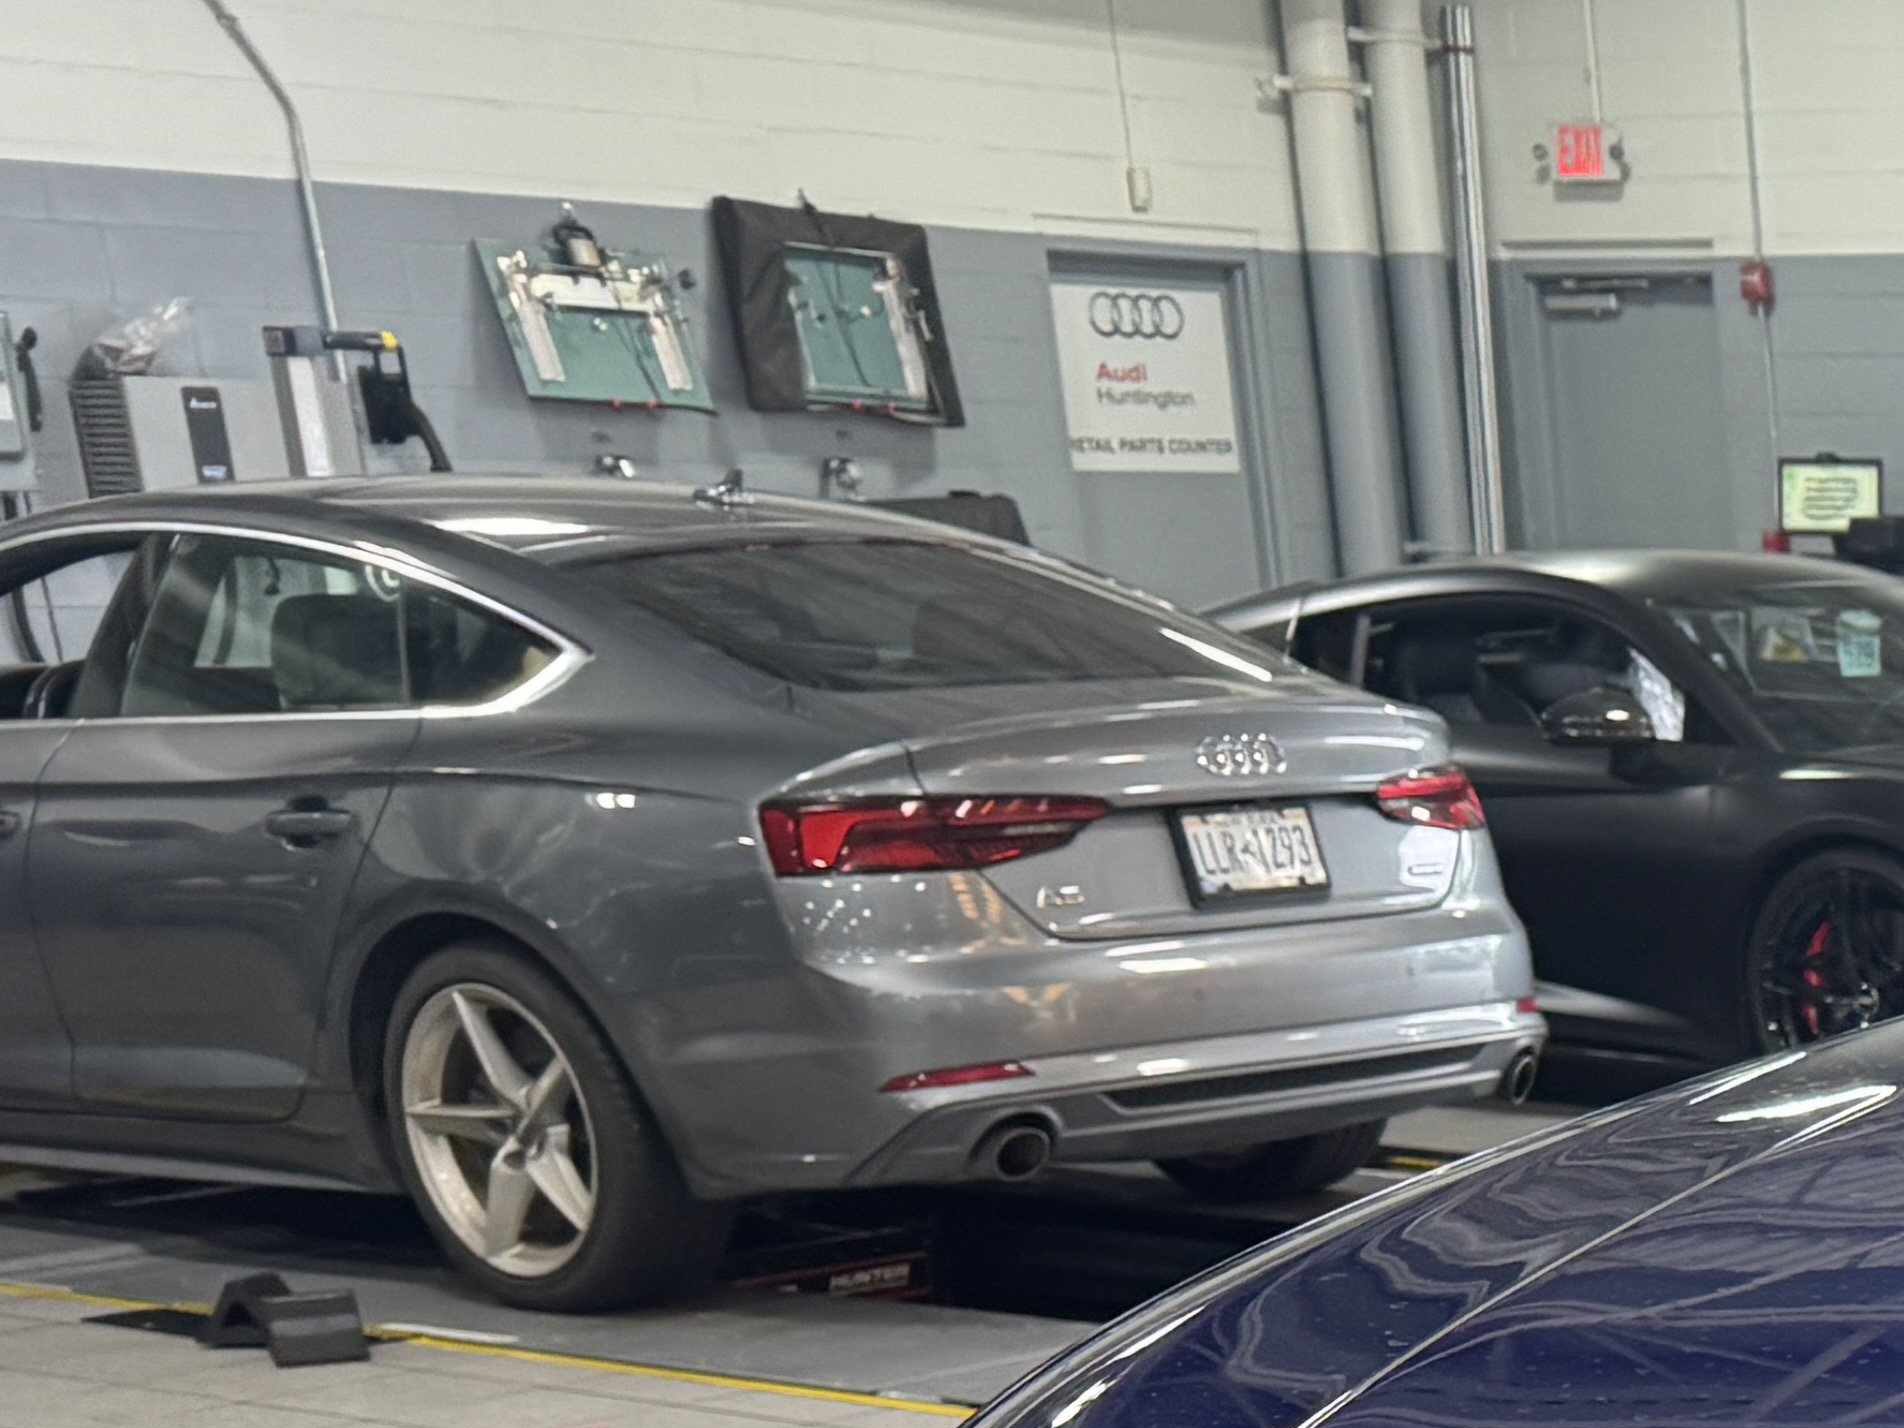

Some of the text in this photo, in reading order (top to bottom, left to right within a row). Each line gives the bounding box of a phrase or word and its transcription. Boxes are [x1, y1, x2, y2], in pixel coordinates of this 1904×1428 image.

[1097, 362, 1147, 383] Audi
[1097, 387, 1196, 411] Huntington
[1119, 437, 1164, 454] PARTS
[1168, 437, 1233, 454] COUNTER
